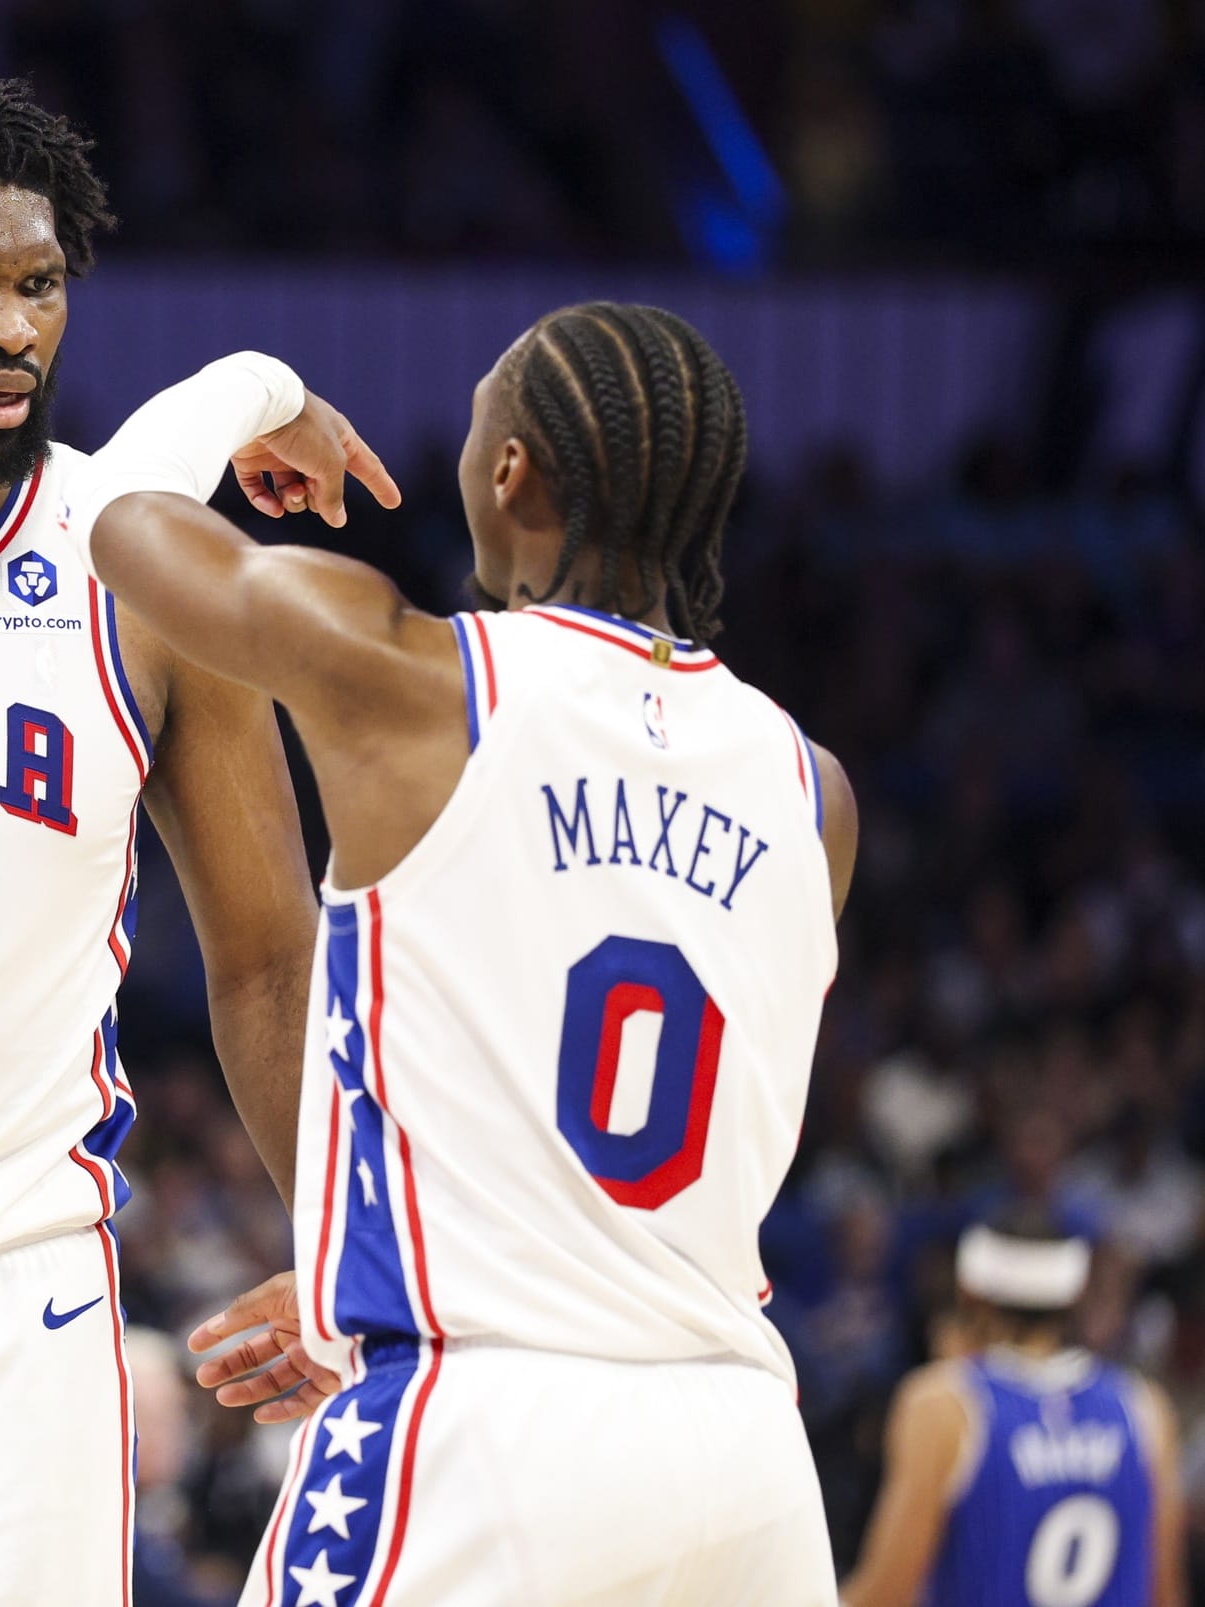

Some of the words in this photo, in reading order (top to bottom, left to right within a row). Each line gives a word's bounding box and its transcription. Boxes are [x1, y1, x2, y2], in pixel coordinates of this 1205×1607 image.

[541, 777, 769, 911] MAXEY
[556, 934, 725, 1212] 0
[1025, 1494, 1121, 1607] 0
